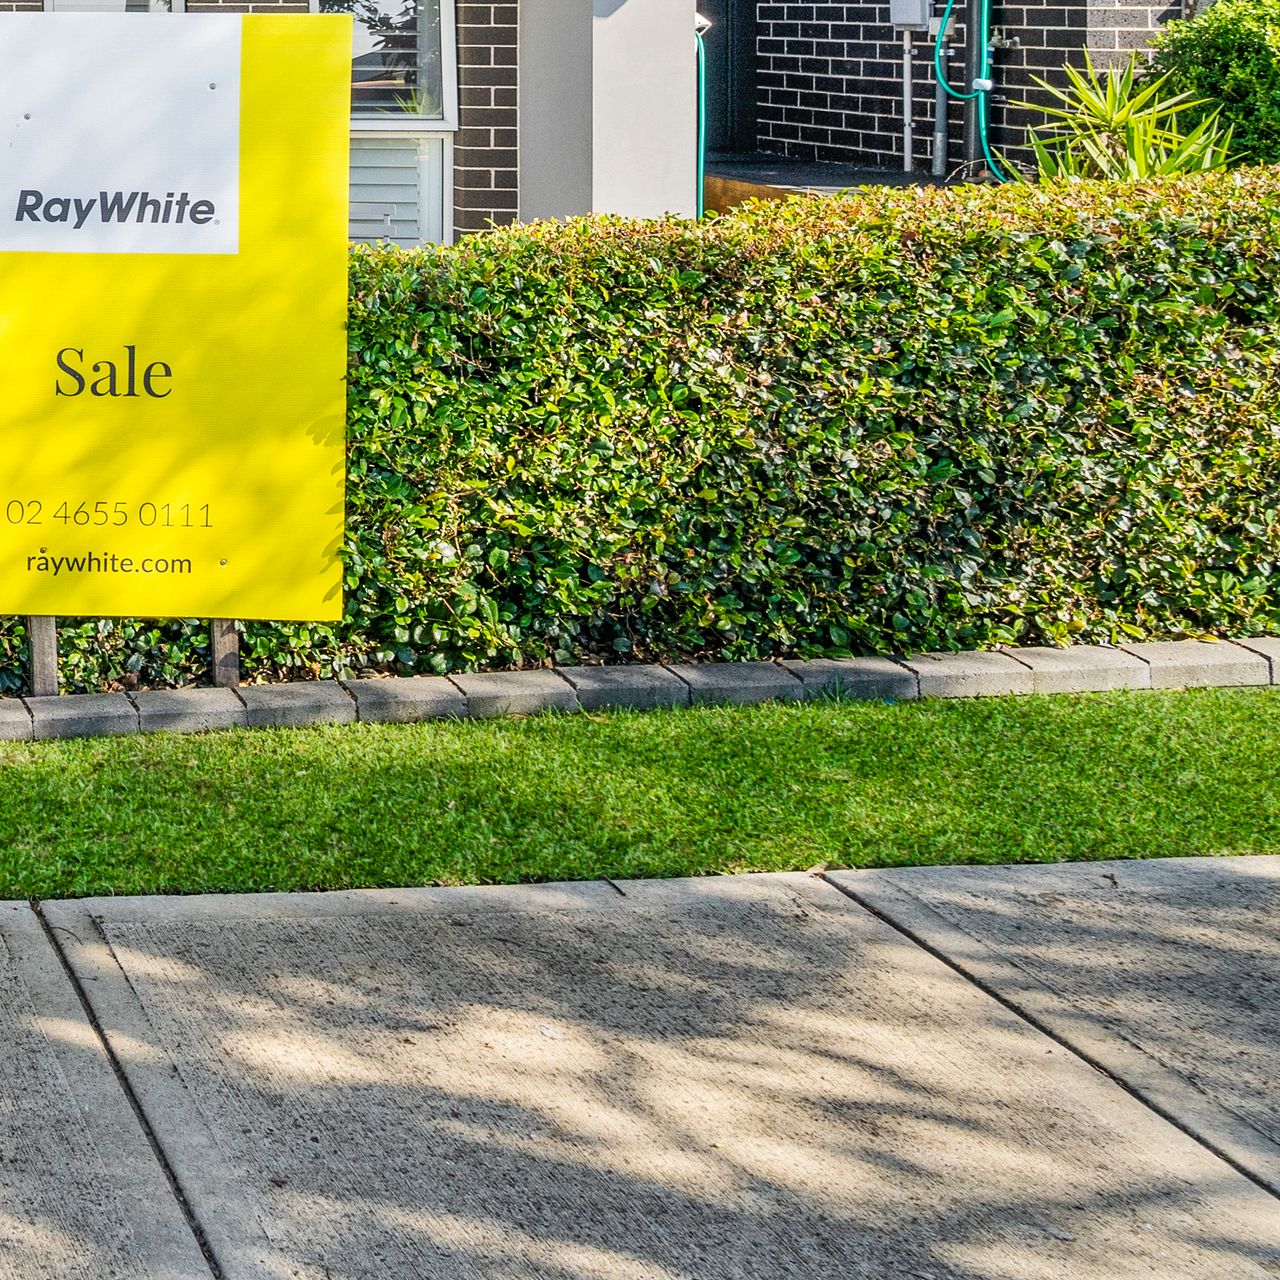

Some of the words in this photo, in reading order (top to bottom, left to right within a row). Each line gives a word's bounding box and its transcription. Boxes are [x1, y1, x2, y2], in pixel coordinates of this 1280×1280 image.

[15, 189, 215, 229] RayWhite
[55, 345, 172, 398] Sale
[6, 500, 42, 524] 02
[53, 501, 128, 526] 4655
[139, 502, 213, 527] 0111
[26, 551, 192, 576] raywhite.com
